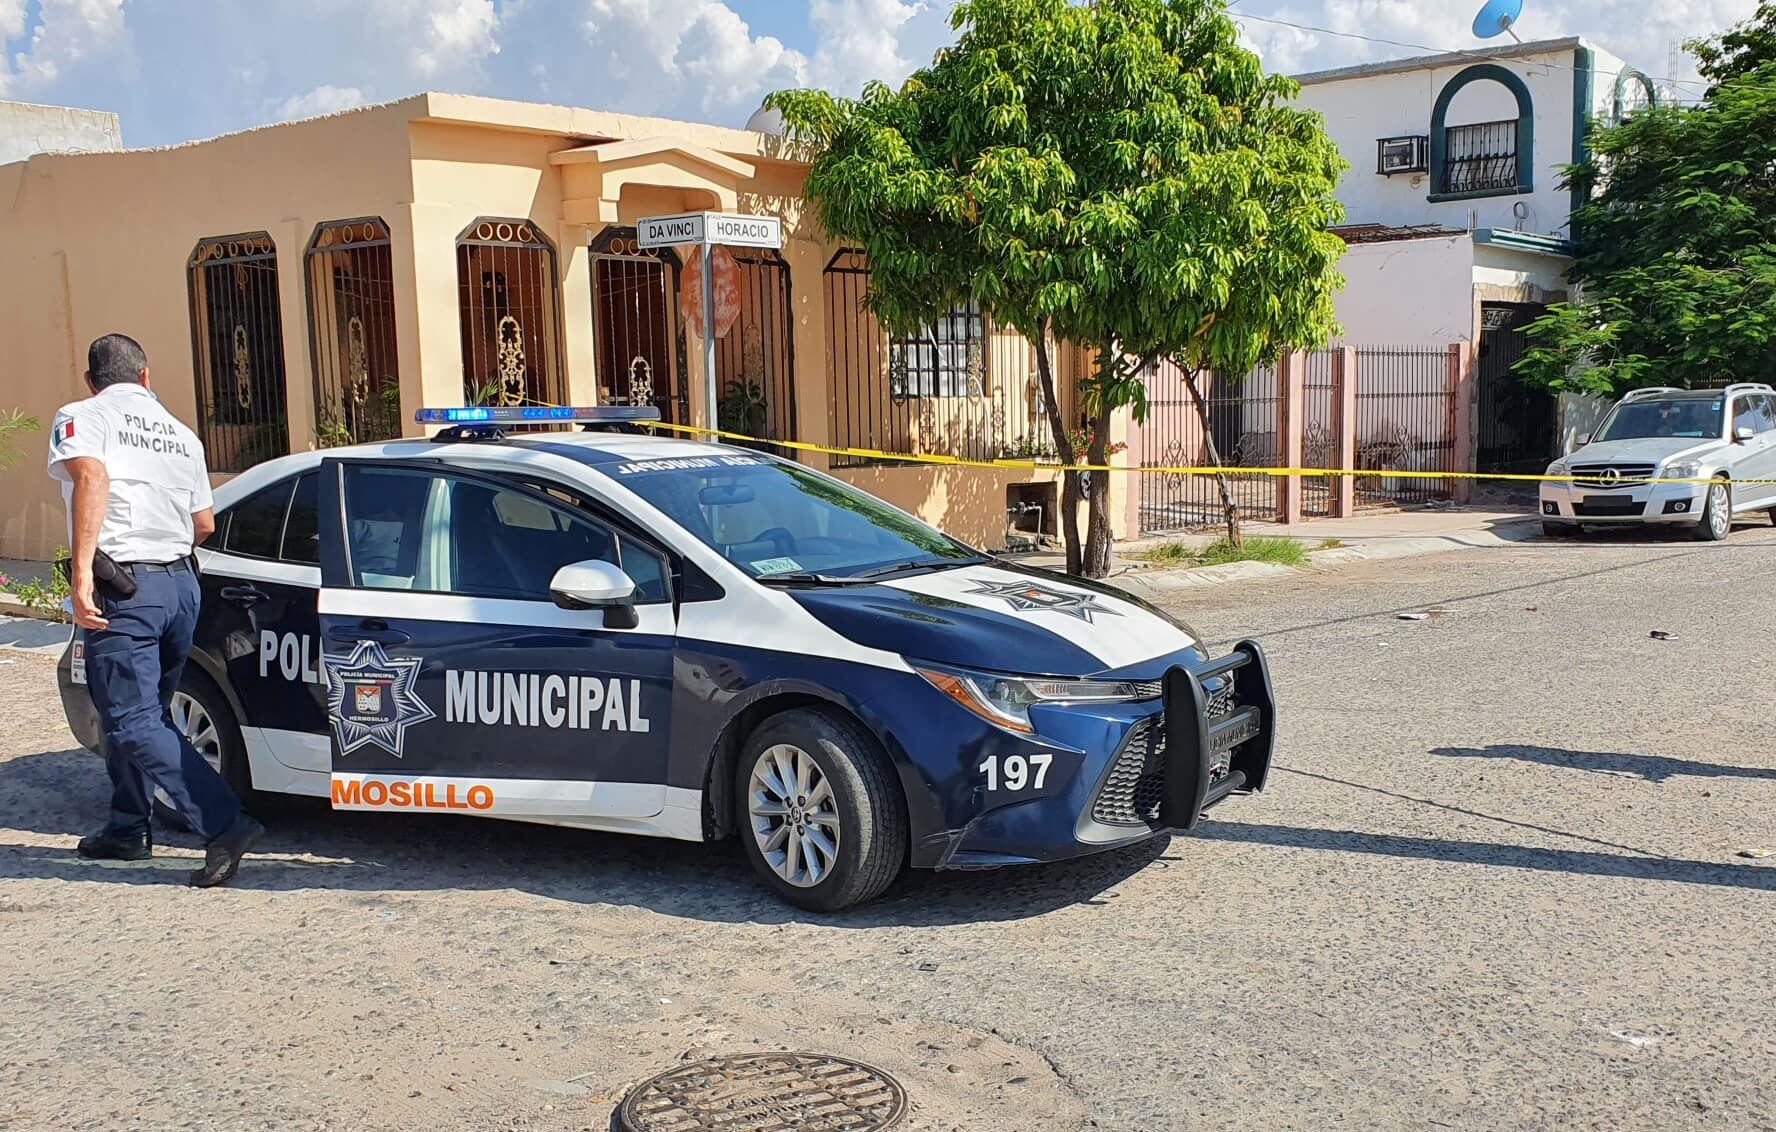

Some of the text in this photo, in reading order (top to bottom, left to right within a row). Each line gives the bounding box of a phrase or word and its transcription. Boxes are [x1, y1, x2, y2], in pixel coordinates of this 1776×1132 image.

[649, 222, 694, 238] DA VINCI
[717, 222, 769, 238] HORACIO
[124, 413, 177, 436] POLCIA
[118, 430, 190, 458] MUNCIPAL
[445, 669, 650, 732] MUNICIPAL
[979, 754, 1053, 791] 197
[331, 779, 495, 810] MOSILLO
